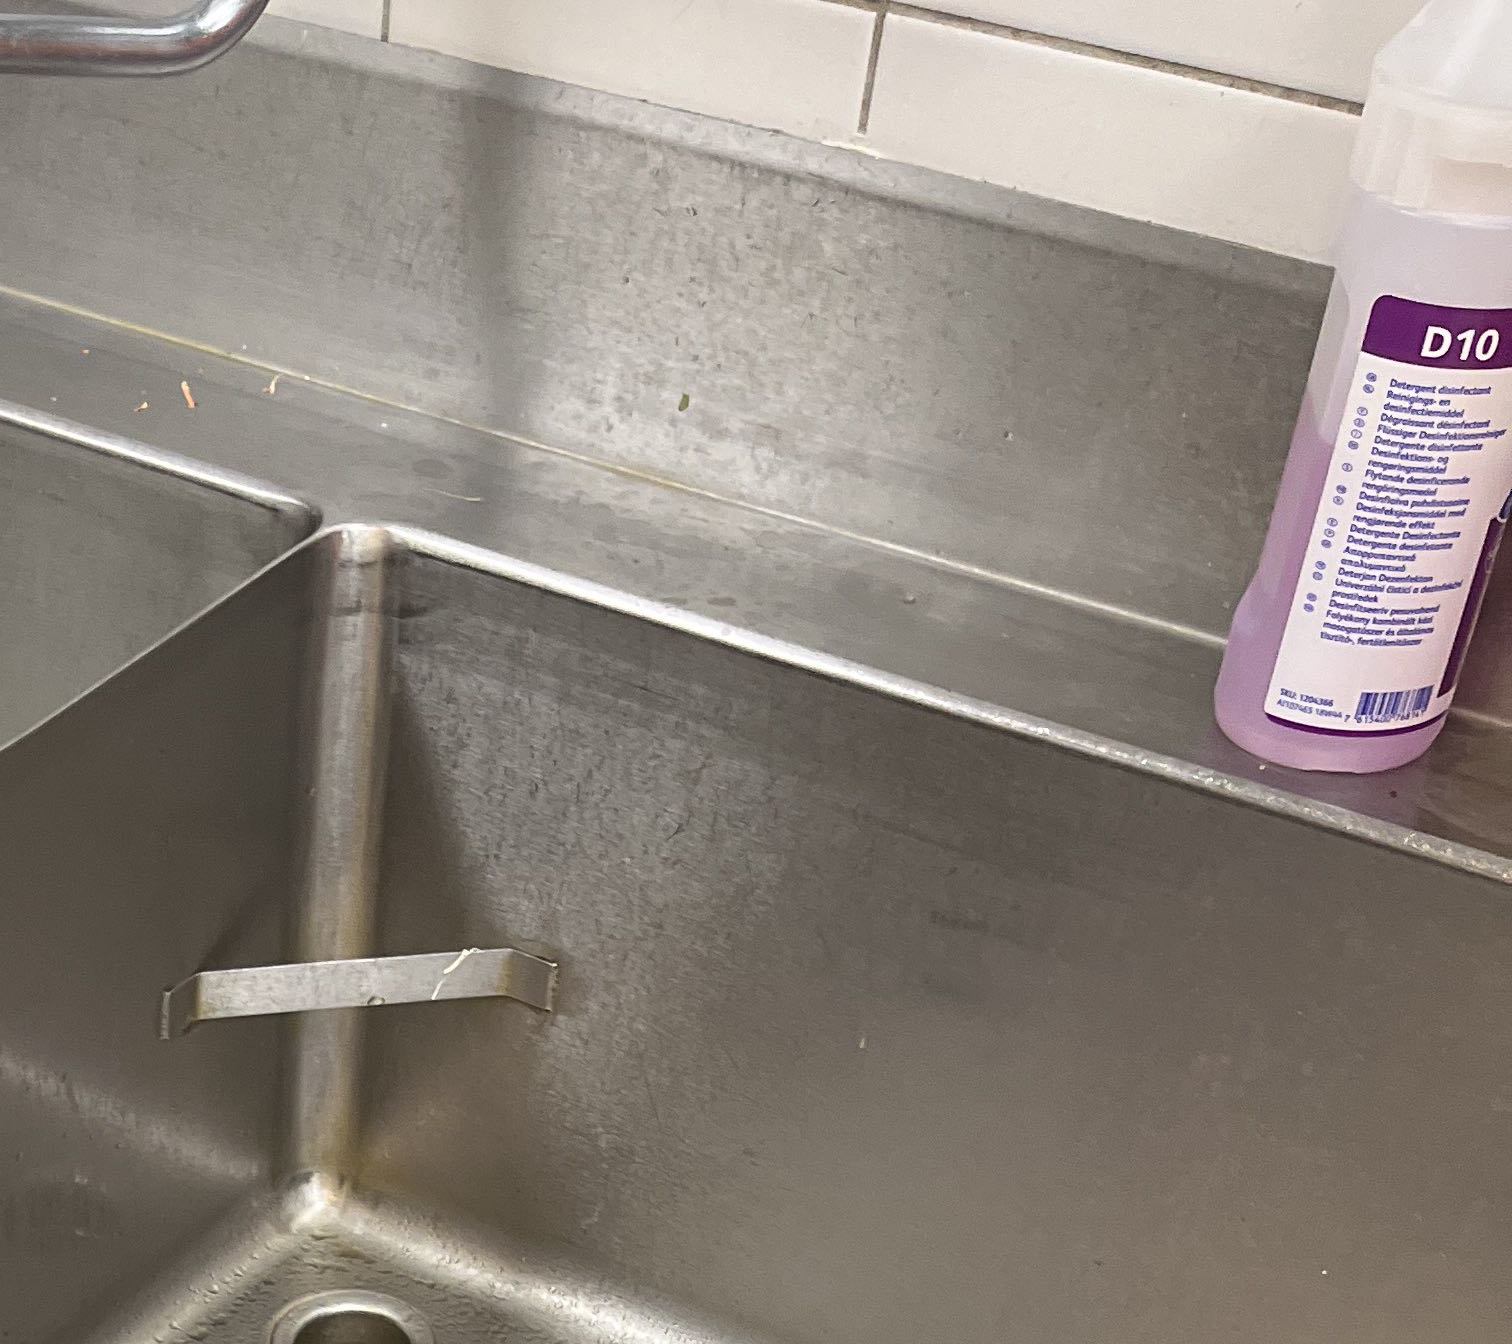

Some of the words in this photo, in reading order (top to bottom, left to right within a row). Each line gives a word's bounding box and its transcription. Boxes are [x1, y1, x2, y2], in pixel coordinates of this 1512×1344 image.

[1420, 325, 1500, 362] D10
[1390, 379, 1436, 394] Detergent
[1438, 386, 1491, 395] disinfectant
[1374, 436, 1426, 450] Detergente
[1350, 524, 1400, 538] Detergente
[1347, 535, 1397, 550] Detergente
